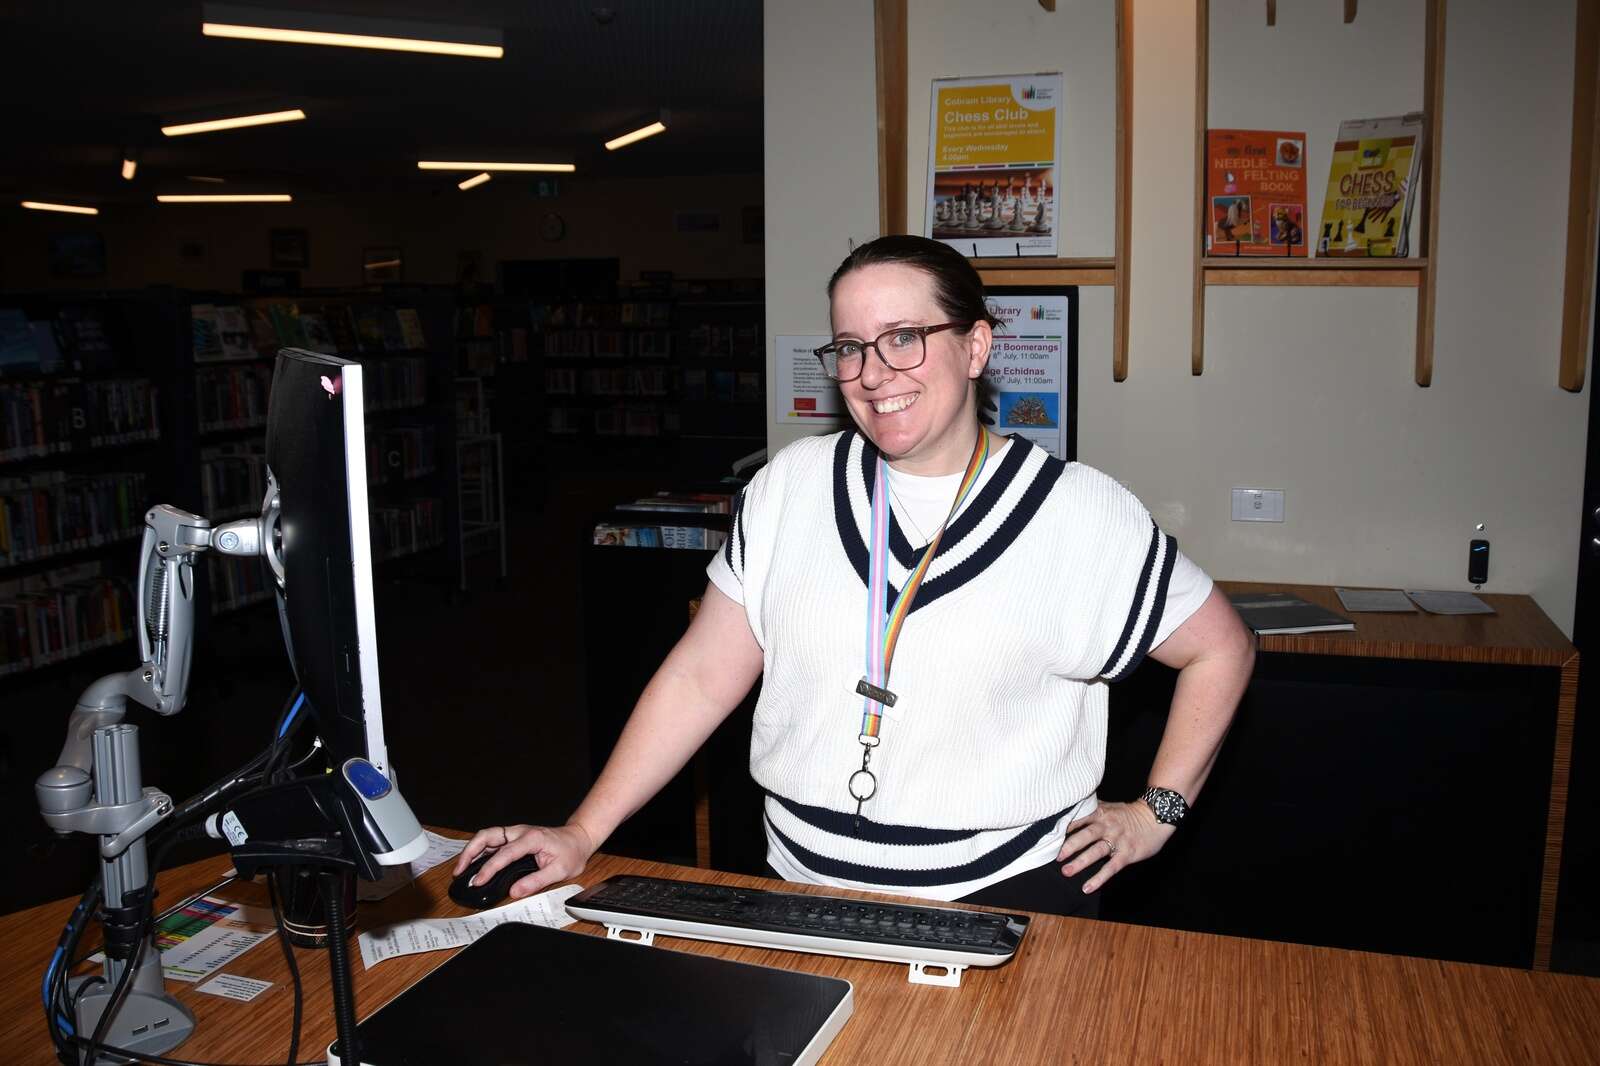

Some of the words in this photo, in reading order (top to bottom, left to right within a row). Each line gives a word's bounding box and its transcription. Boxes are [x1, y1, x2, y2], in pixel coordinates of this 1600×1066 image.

[981, 95, 1011, 105] Library
[944, 111, 990, 124] Chess
[994, 108, 1028, 121] Club
[942, 145, 963, 153] Every
[966, 143, 1009, 152] Wednesday
[1214, 158, 1272, 169] NEEDLE-
[1244, 169, 1299, 181] FELTING
[1260, 182, 1294, 192] BOOK
[1340, 170, 1396, 196] CHESS
[1003, 343, 1059, 353] Boomerangs
[1003, 367, 1046, 376] Echidnas
[72, 407, 87, 430] B
